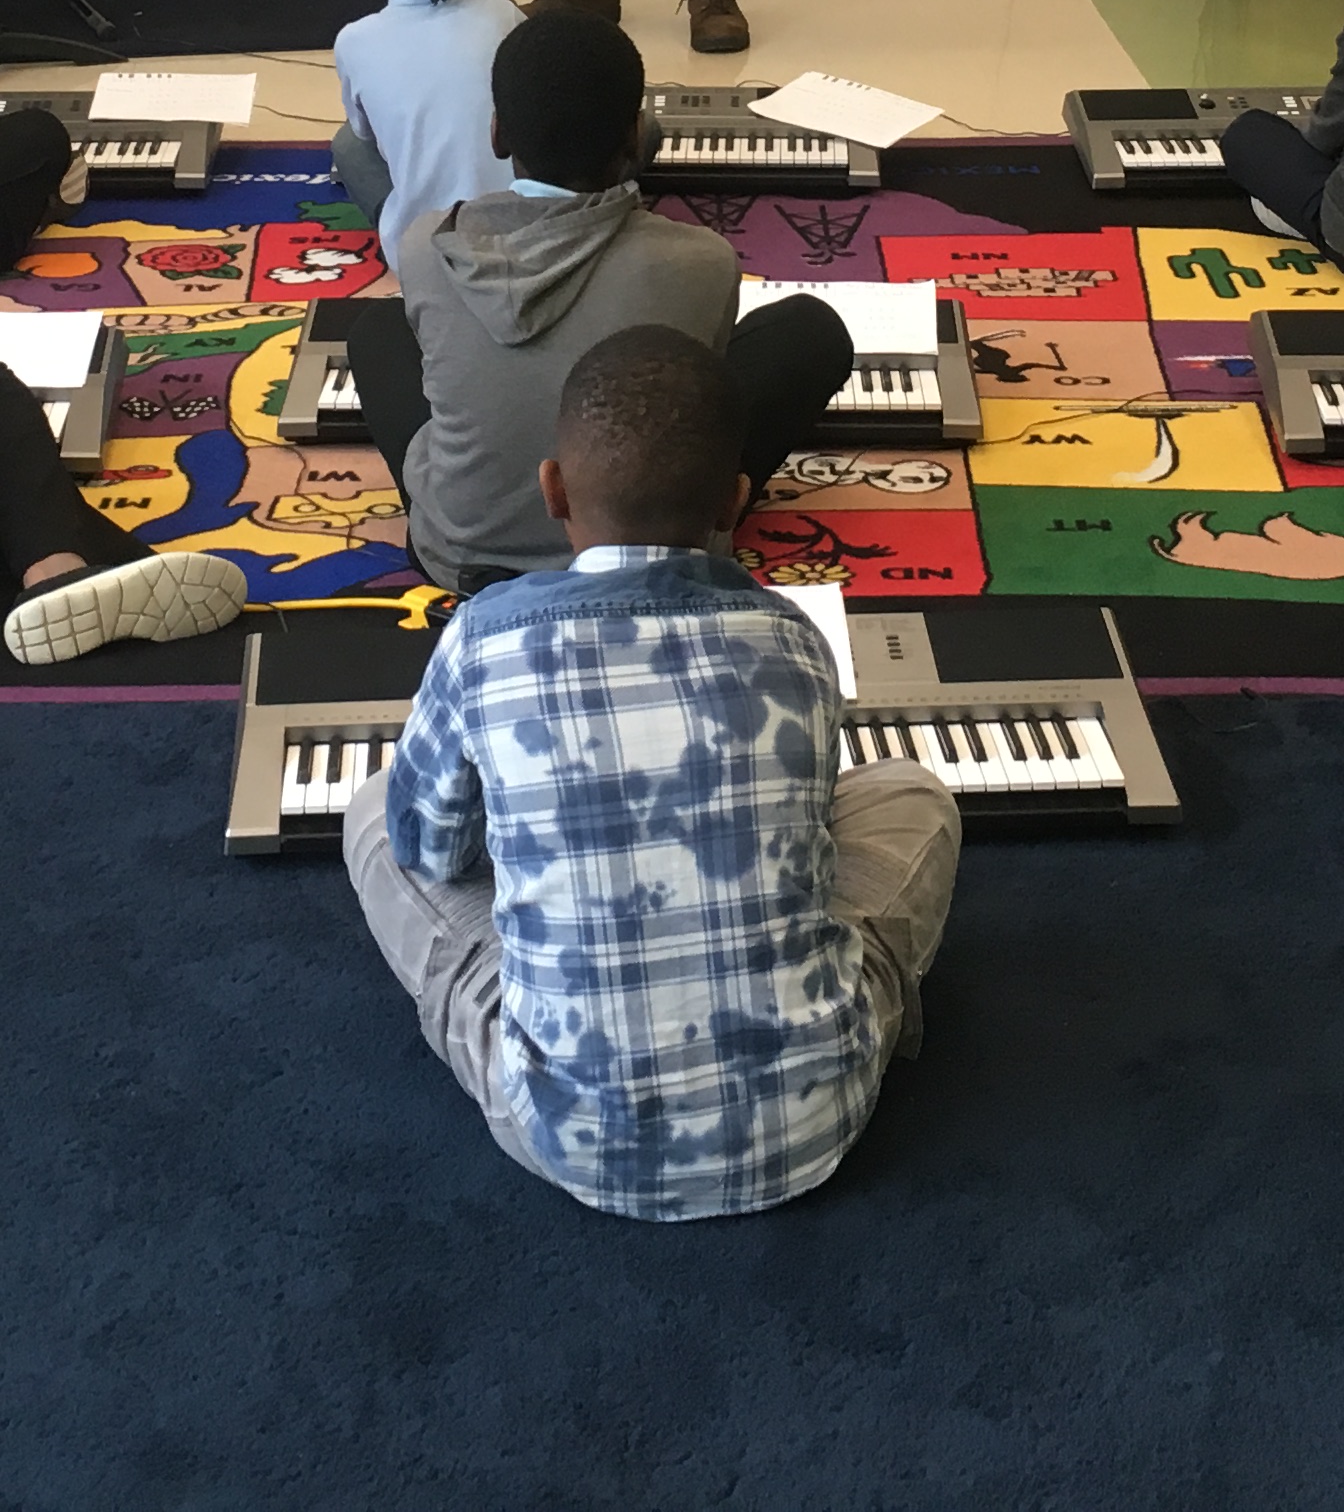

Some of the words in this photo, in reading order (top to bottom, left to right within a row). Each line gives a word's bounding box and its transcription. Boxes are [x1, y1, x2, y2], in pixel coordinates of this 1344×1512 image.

[910, 164, 1040, 175] MEXIC
[212, 173, 332, 185] Mexic
[950, 251, 1010, 261] NM
[50, 282, 102, 292] GA
[174, 283, 224, 292] AL
[1285, 287, 1340, 296] AZ
[184, 336, 237, 347] KY
[160, 373, 204, 384] IN
[1053, 375, 1111, 386] CO
[1021, 433, 1093, 445] WY
[306, 470, 362, 483] WI
[98, 496, 153, 510] MI
[1045, 518, 1113, 532] MT
[880, 566, 954, 581] ND
